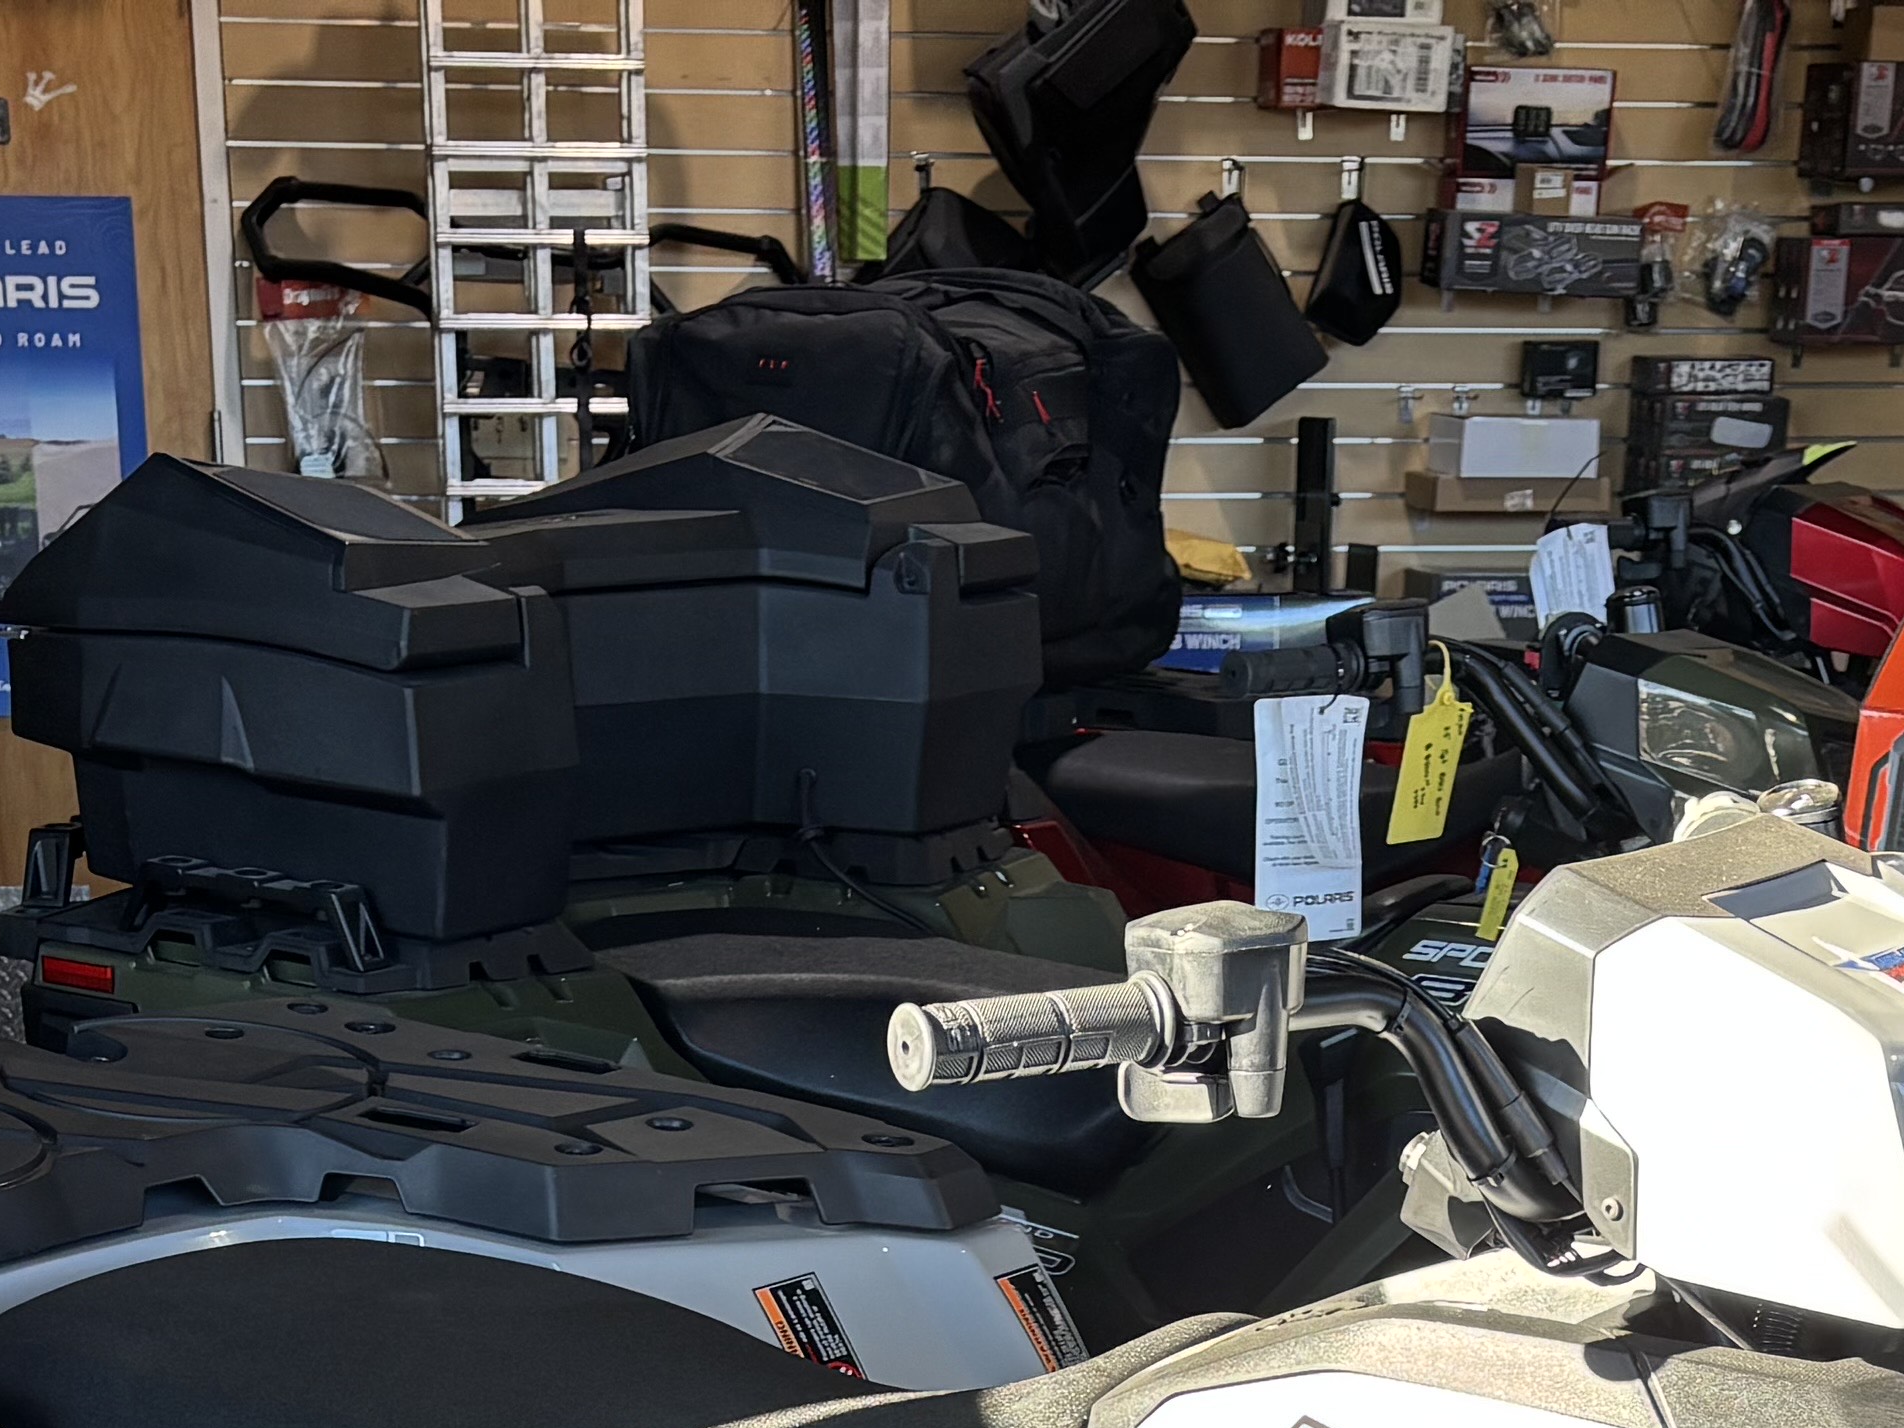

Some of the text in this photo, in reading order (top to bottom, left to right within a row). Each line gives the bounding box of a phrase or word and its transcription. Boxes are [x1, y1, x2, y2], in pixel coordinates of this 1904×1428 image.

[1284, 32, 1324, 47] KOL
[4, 240, 68, 256] LEAD
[17, 332, 82, 349] ROAM
[1185, 633, 1242, 650] WINCH
[1292, 890, 1356, 908] POLARIS
